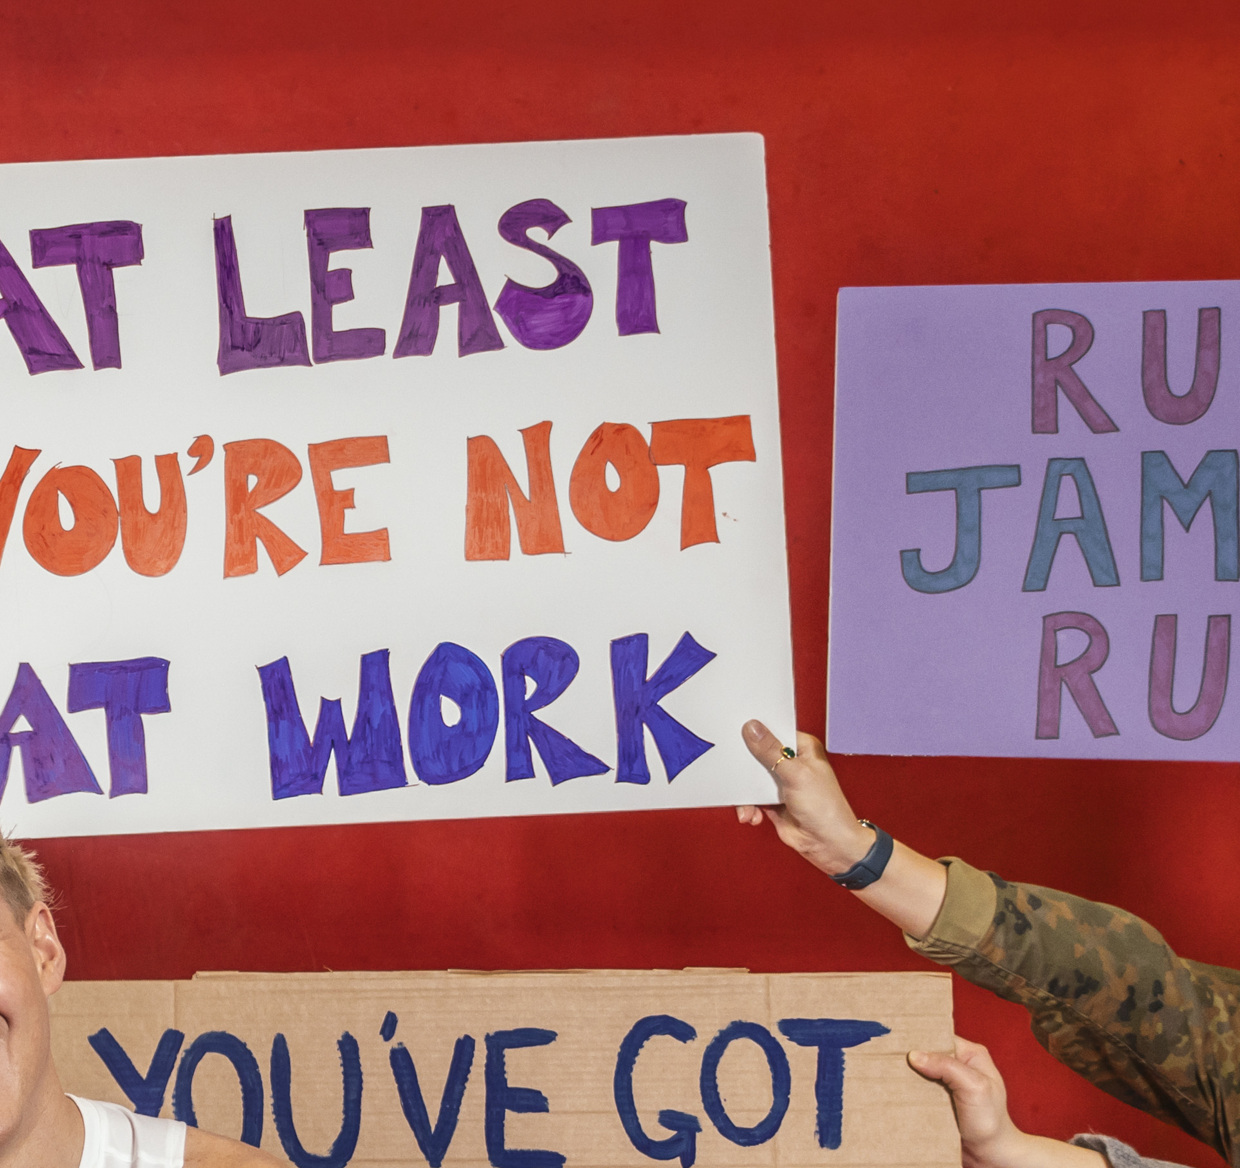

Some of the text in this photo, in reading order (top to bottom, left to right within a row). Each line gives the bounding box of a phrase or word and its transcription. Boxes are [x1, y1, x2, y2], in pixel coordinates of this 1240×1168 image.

[212, 198, 688, 376] LEAST
[1031, 306, 1222, 435] RU
[464, 415, 757, 562] NOT
[899, 449, 1240, 595] JAM
[255, 631, 717, 801] WORK
[1035, 611, 1232, 741] RU
